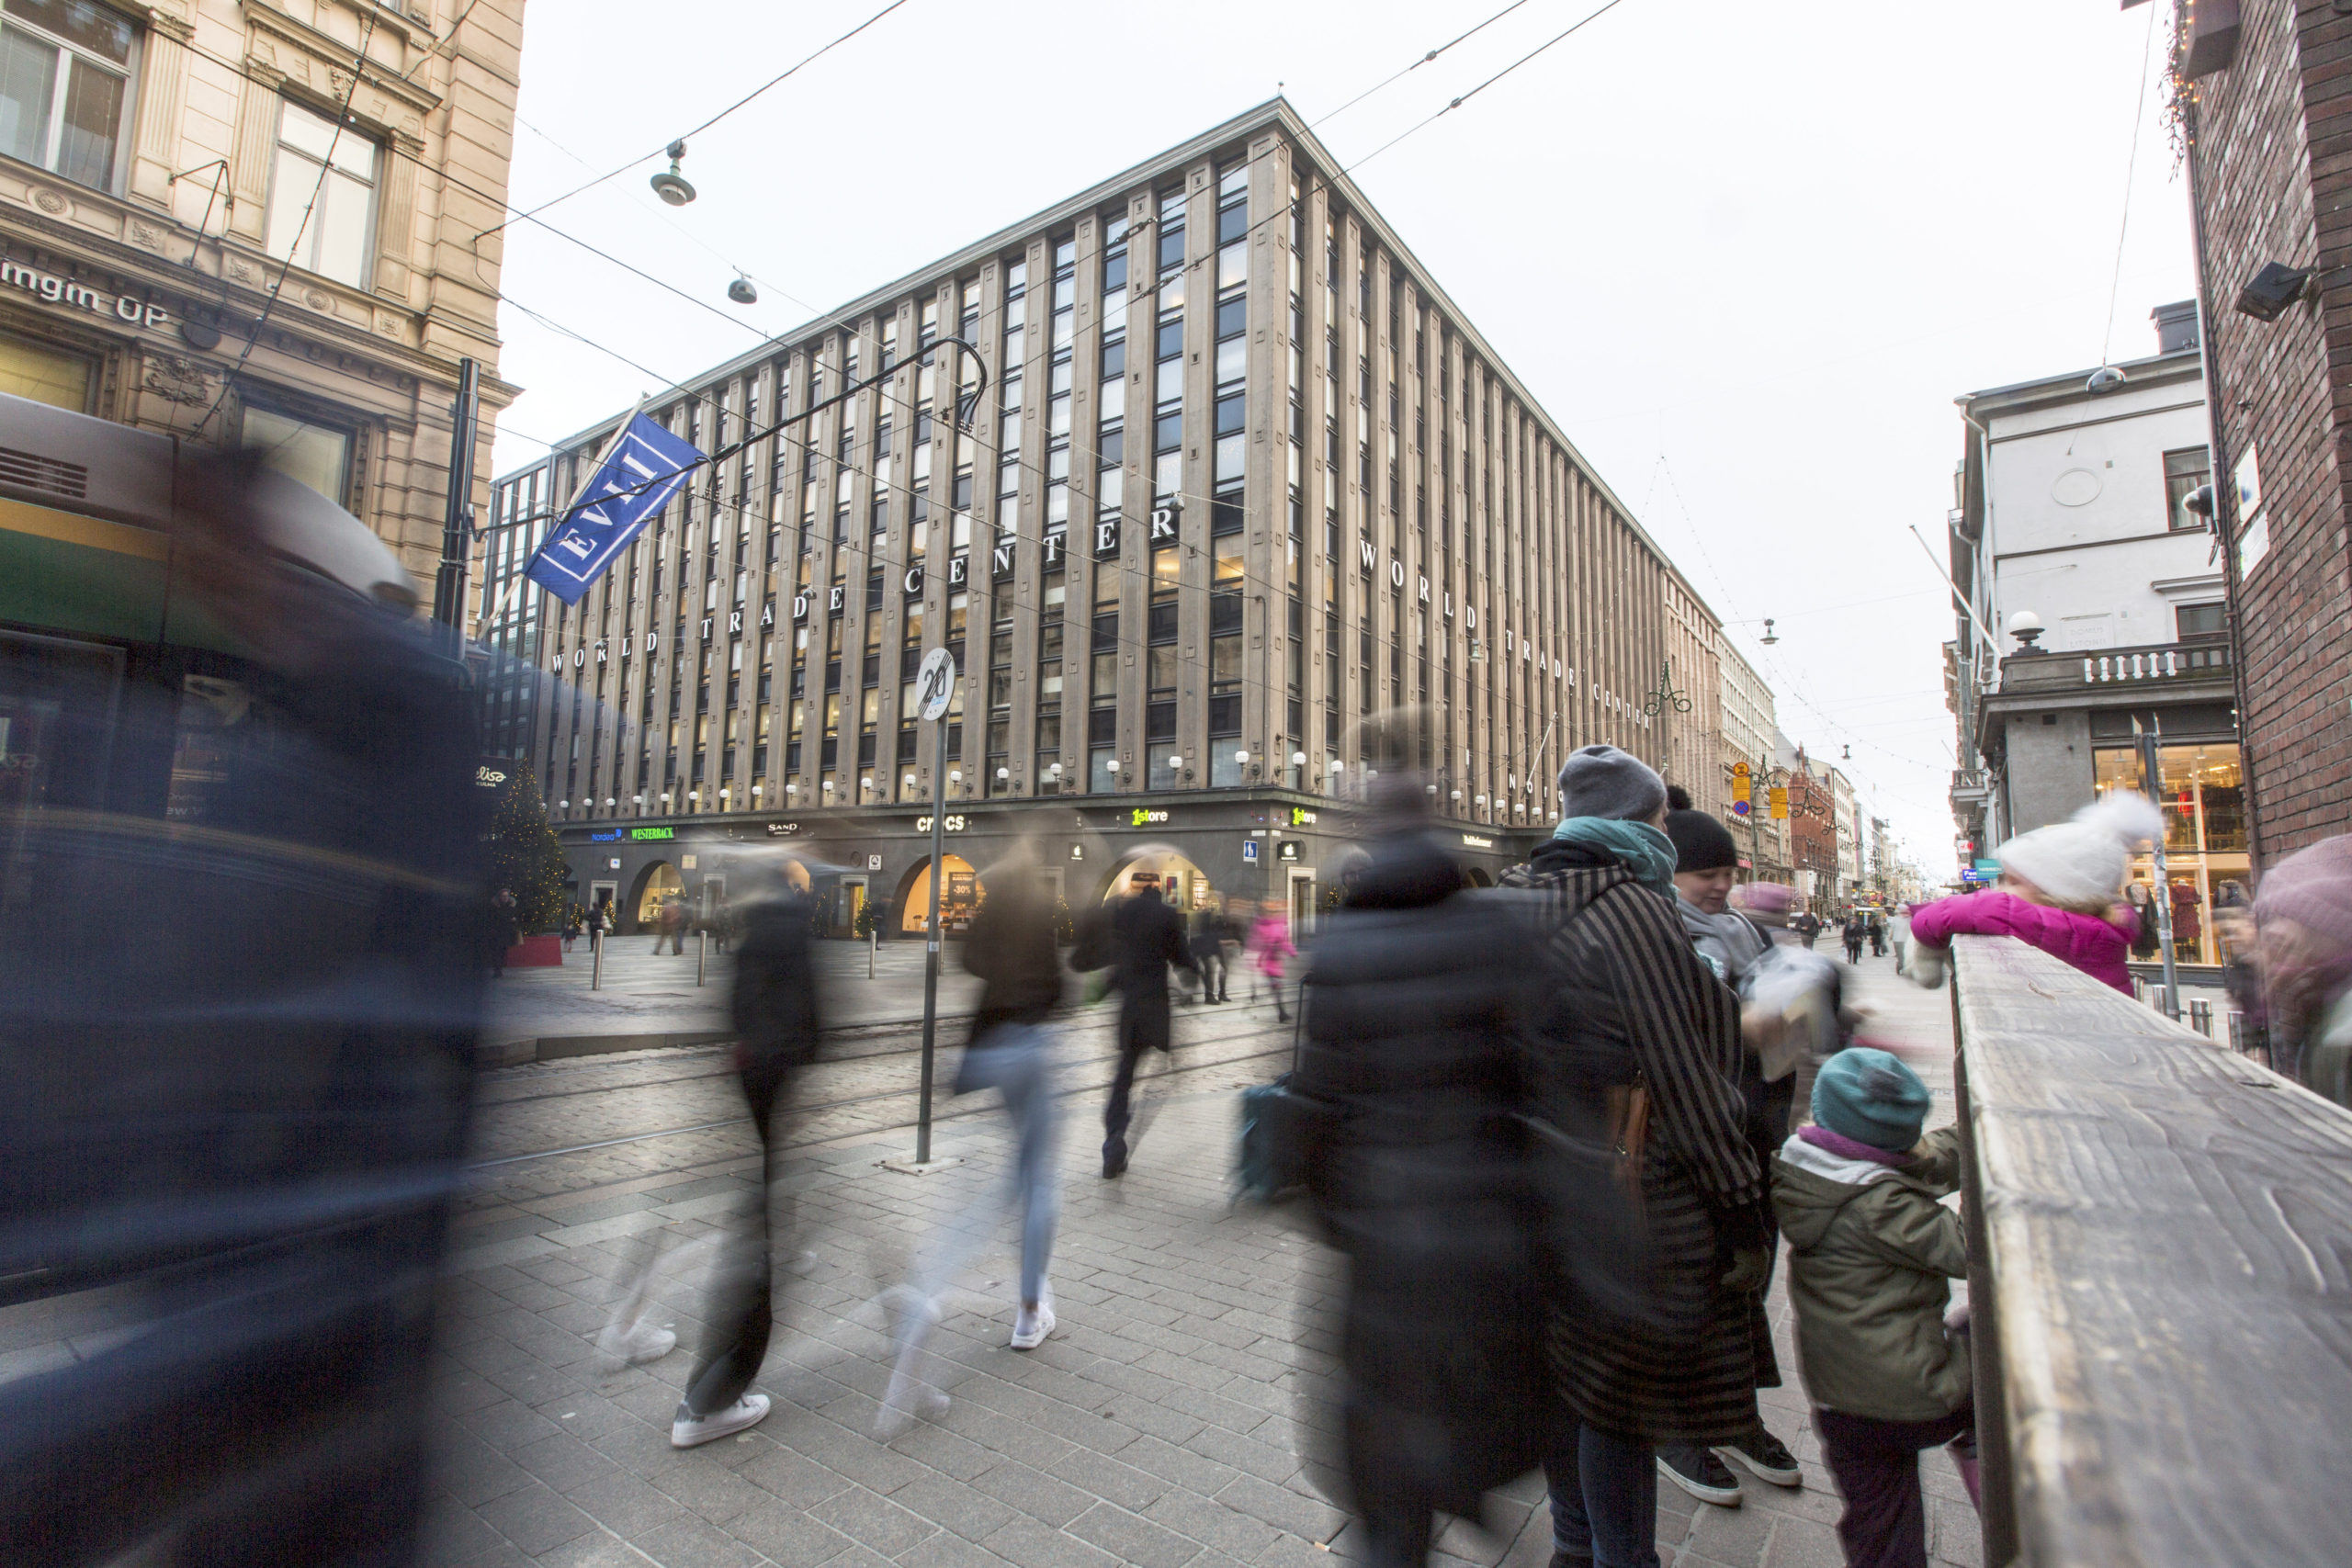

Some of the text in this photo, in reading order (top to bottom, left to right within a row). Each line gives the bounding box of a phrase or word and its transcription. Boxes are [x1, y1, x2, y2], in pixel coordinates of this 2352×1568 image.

[559, 452, 658, 561] EVLI
[551, 509, 1177, 672] WORLD TRADE CENTER
[1360, 539, 1650, 730] WORLD TRADE CENTER
[917, 816, 965, 831] crcs
[1132, 808, 1169, 826] 1store
[1293, 807, 1317, 826] 1store
[768, 823, 797, 831] SAND
[592, 832, 616, 842] Nordea
